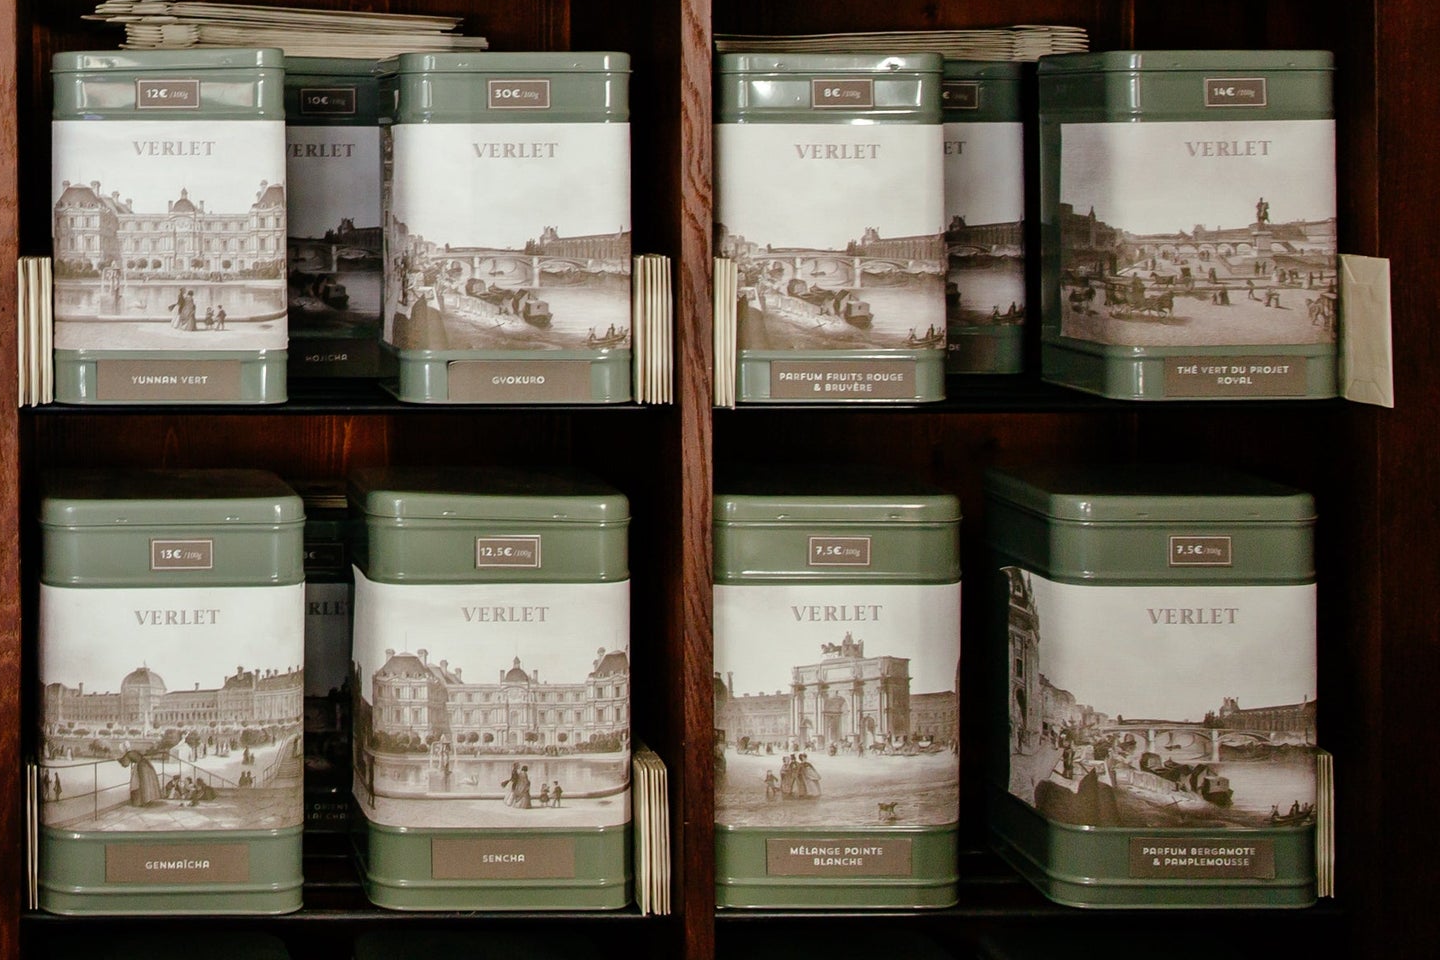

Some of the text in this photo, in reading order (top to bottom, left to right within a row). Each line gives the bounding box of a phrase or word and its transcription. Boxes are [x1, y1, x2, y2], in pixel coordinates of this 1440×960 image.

[146, 89, 167, 98] 12€
[495, 89, 520, 98] 30€
[824, 88, 840, 97] 8€
[1214, 87, 1235, 96] 14€
[131, 141, 216, 156] VERLET
[471, 143, 558, 158] VERLET
[793, 144, 880, 159] VERLET
[1183, 141, 1272, 156] VERLET
[1177, 365, 1197, 374] THÉ
[1202, 366, 1227, 374] VERT
[132, 376, 207, 384] YUNNAN VERT
[827, 373, 862, 381] FRUITS
[867, 373, 903, 381] ROUGE
[160, 549, 182, 559] 13€
[133, 610, 220, 625] VERLET
[460, 607, 549, 622] VERLET
[790, 605, 882, 621] VERLET
[1147, 608, 1239, 624] VERLET
[790, 846, 840, 855] MÉLANGE
[483, 854, 524, 862] SENCHA
[146, 860, 209, 869] GENMAÏCHA
